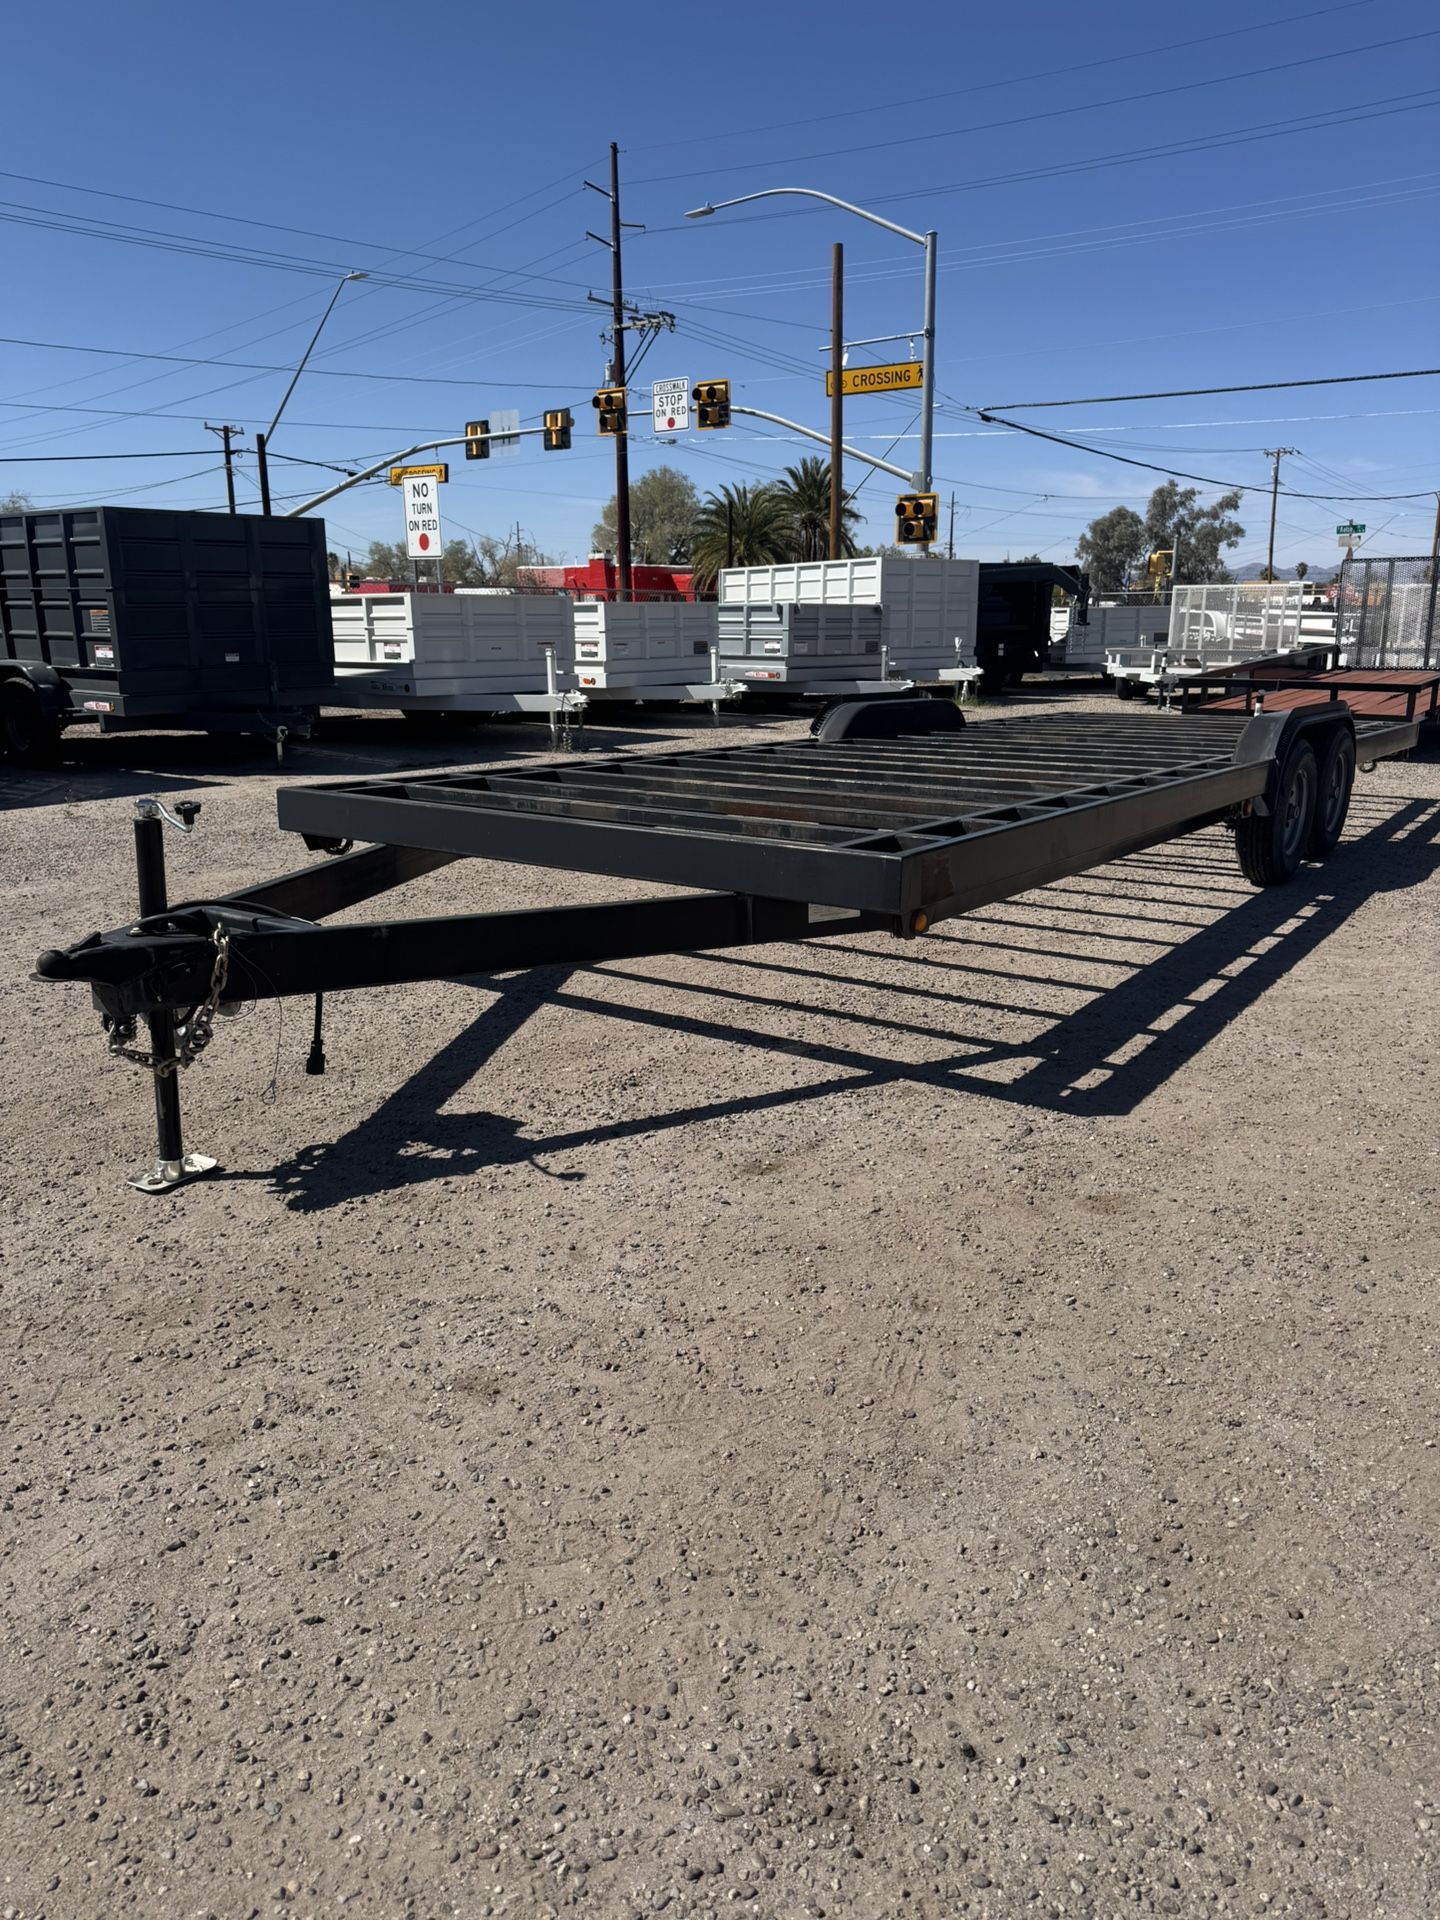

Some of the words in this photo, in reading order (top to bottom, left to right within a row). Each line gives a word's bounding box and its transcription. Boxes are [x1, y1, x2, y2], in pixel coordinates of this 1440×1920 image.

[852, 369, 911, 388] CROSSING
[655, 381, 686, 393] CROSSWALK
[658, 394, 683, 408] STOP
[655, 409, 667, 418] ON
[670, 406, 687, 416] RED
[412, 482, 429, 498] NO
[411, 503, 433, 515] TURN
[408, 520, 420, 532] ON
[421, 519, 438, 531] RED
